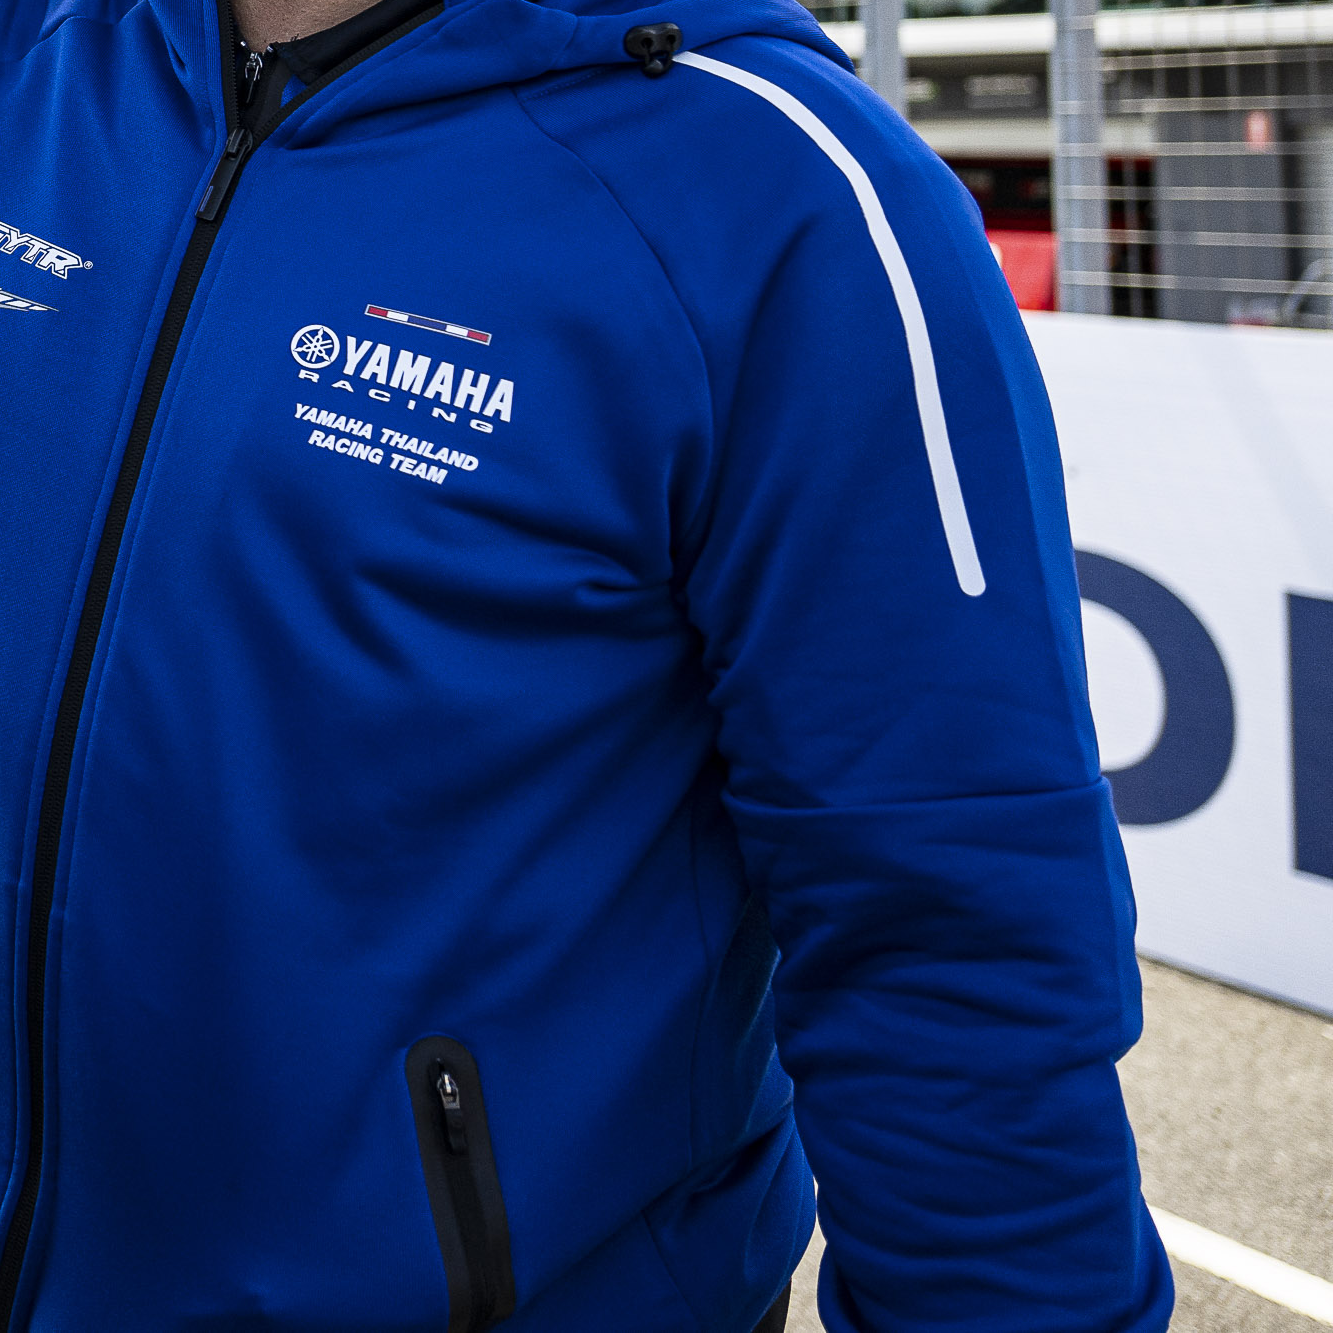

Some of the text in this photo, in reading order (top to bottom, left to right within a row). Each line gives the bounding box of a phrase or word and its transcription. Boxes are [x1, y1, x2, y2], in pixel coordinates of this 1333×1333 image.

[298, 369, 494, 434] RACING
[342, 335, 515, 423] YAMAHA
[294, 403, 480, 472] YAMAHA THAILAND
[307, 430, 449, 485] RACING TEAM
